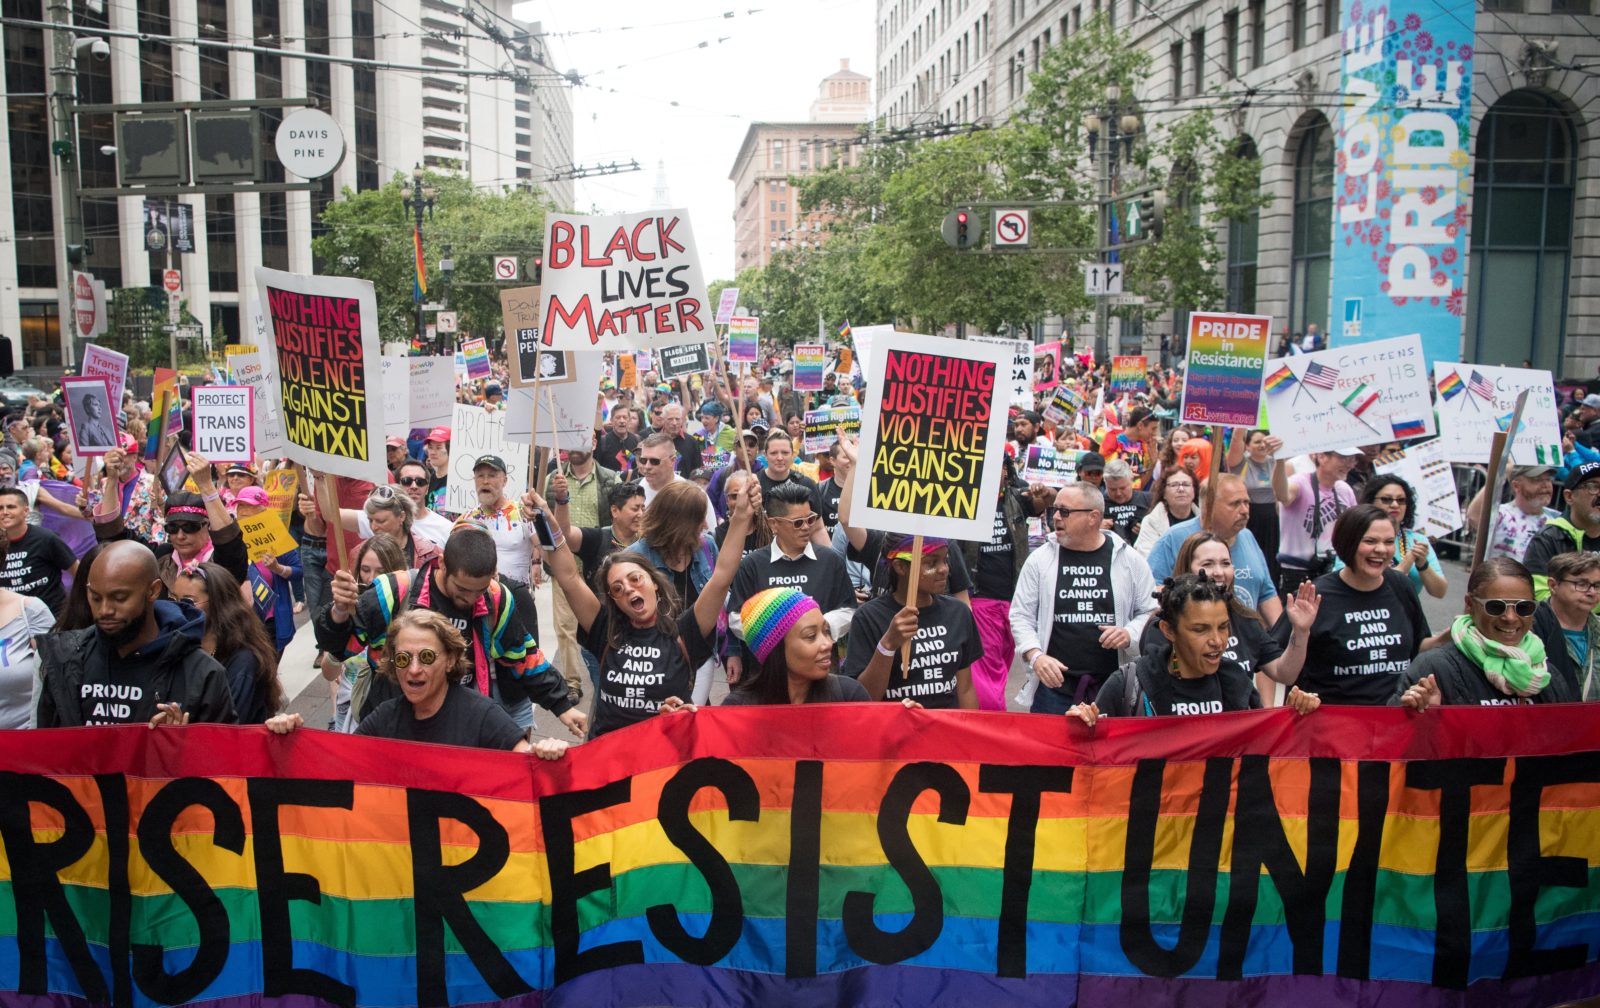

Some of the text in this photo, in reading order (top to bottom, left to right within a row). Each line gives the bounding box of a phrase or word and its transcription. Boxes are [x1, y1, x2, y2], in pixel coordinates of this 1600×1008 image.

[1340, 13, 1385, 224] LOVE
[290, 130, 328, 139] DAVIS
[294, 149, 325, 158] PINE
[1388, 60, 1463, 297] PRIDE
[549, 216, 685, 269] BLACK
[601, 265, 690, 303] LIVES
[267, 286, 360, 328] NOTHING
[508, 299, 540, 312] DONA
[541, 294, 704, 346] MATTER
[1198, 321, 1262, 340] PRIDE
[274, 320, 362, 360] JUSTIFIES
[1221, 340, 1234, 350] in
[664, 344, 702, 357] BLACK LIVES
[798, 348, 822, 356] PRIDE
[1338, 347, 1414, 368] CITIZENS
[92, 354, 120, 372] Trans
[1119, 358, 1140, 368] LOVE
[1191, 351, 1262, 369] Resistance
[278, 350, 365, 394] VIOLENCE
[884, 351, 995, 390] NOTHING
[1120, 382, 1138, 390] HATE
[1338, 374, 1376, 389] RESIST
[198, 394, 246, 405] PROTECT
[282, 382, 365, 424] AGAINST
[881, 382, 991, 421] JUSTIFIES
[1492, 396, 1518, 410] RESI
[198, 416, 246, 429] TRANS
[806, 412, 860, 424] Trans Rights
[817, 424, 837, 432] human
[880, 412, 988, 454] VIOLENCE
[284, 412, 368, 460] WOMXN
[199, 437, 246, 452] LIVES
[1041, 450, 1054, 458] No
[872, 445, 984, 484] AGAINST
[1038, 459, 1076, 470] No Wall!
[871, 476, 979, 520] WOMXN
[1109, 505, 1137, 514] PROUD
[244, 522, 265, 534] Ban
[251, 532, 276, 546] Wall
[4, 552, 28, 560] ROUD
[0, 566, 32, 578] CANNOT
[6, 560, 23, 570] AND
[1062, 566, 1104, 576] PROUD
[11, 578, 23, 586] BE
[768, 575, 808, 586] PROUD
[1072, 578, 1098, 586] AND
[1059, 589, 1108, 599] CANNOT
[1078, 602, 1094, 610] BE
[1054, 614, 1115, 623] NTIMIDATE
[1344, 608, 1390, 624] PROUD
[1360, 622, 1387, 634] AND
[916, 639, 944, 654] AND
[1346, 634, 1402, 650] CANNOT
[1370, 648, 1388, 660] BE
[622, 660, 654, 672] AND
[1334, 659, 1410, 675] INTIMIDATE
[606, 670, 665, 685] CANNOT
[924, 668, 944, 680] BE
[81, 684, 142, 700] PROUD
[626, 688, 646, 698] BE
[600, 689, 665, 711] NTIMIDAT
[92, 702, 130, 718] AND
[0, 751, 1600, 1008] RISE RESIST UNITE
